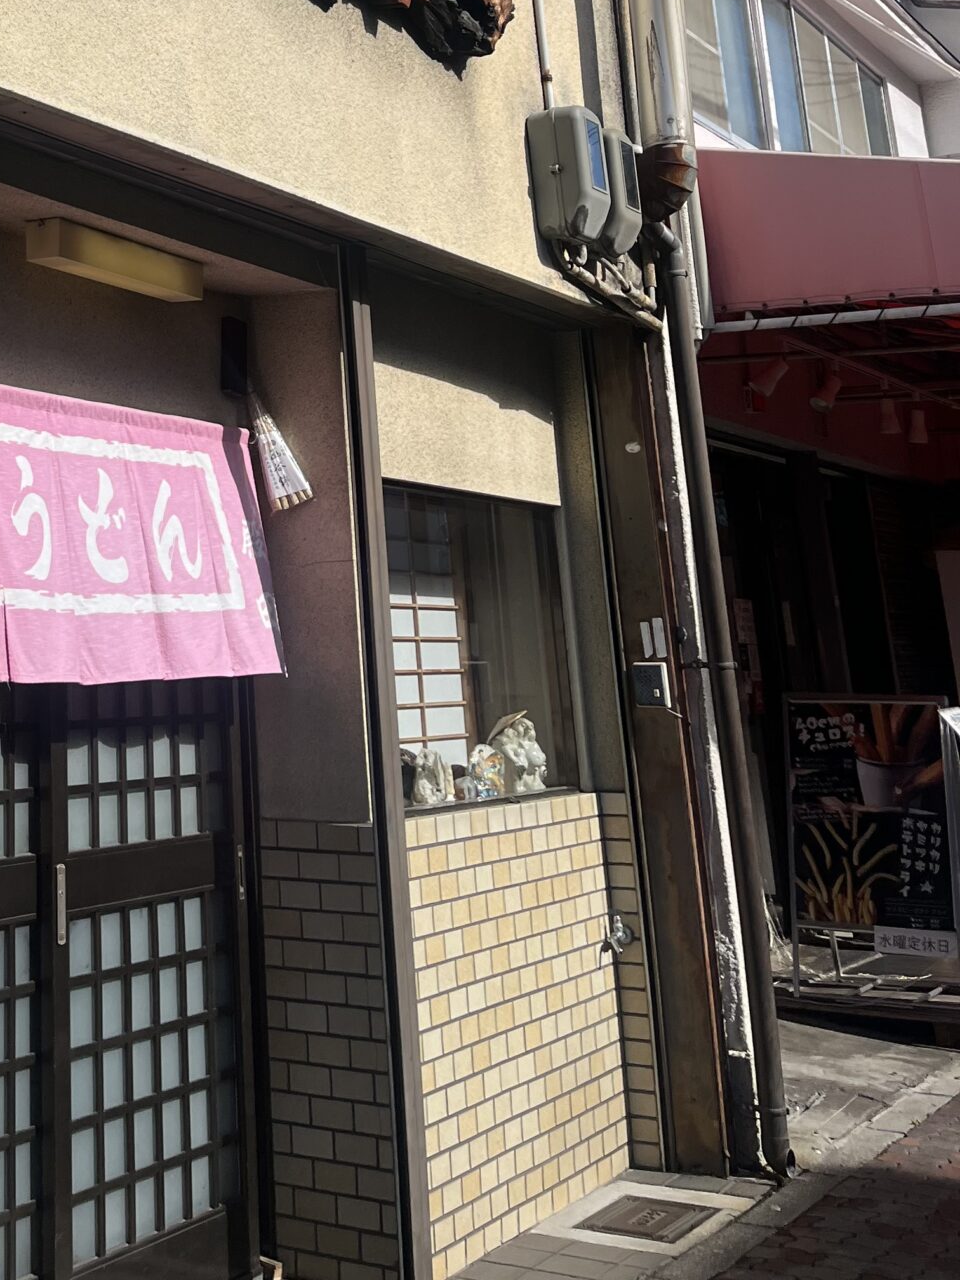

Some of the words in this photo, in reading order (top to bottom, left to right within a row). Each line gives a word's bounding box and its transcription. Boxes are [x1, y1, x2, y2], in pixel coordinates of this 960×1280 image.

[10, 454, 203, 584] うどん
[898, 816, 915, 898] ポテトフライ
[879, 934, 950, 953] 水曜定休日
